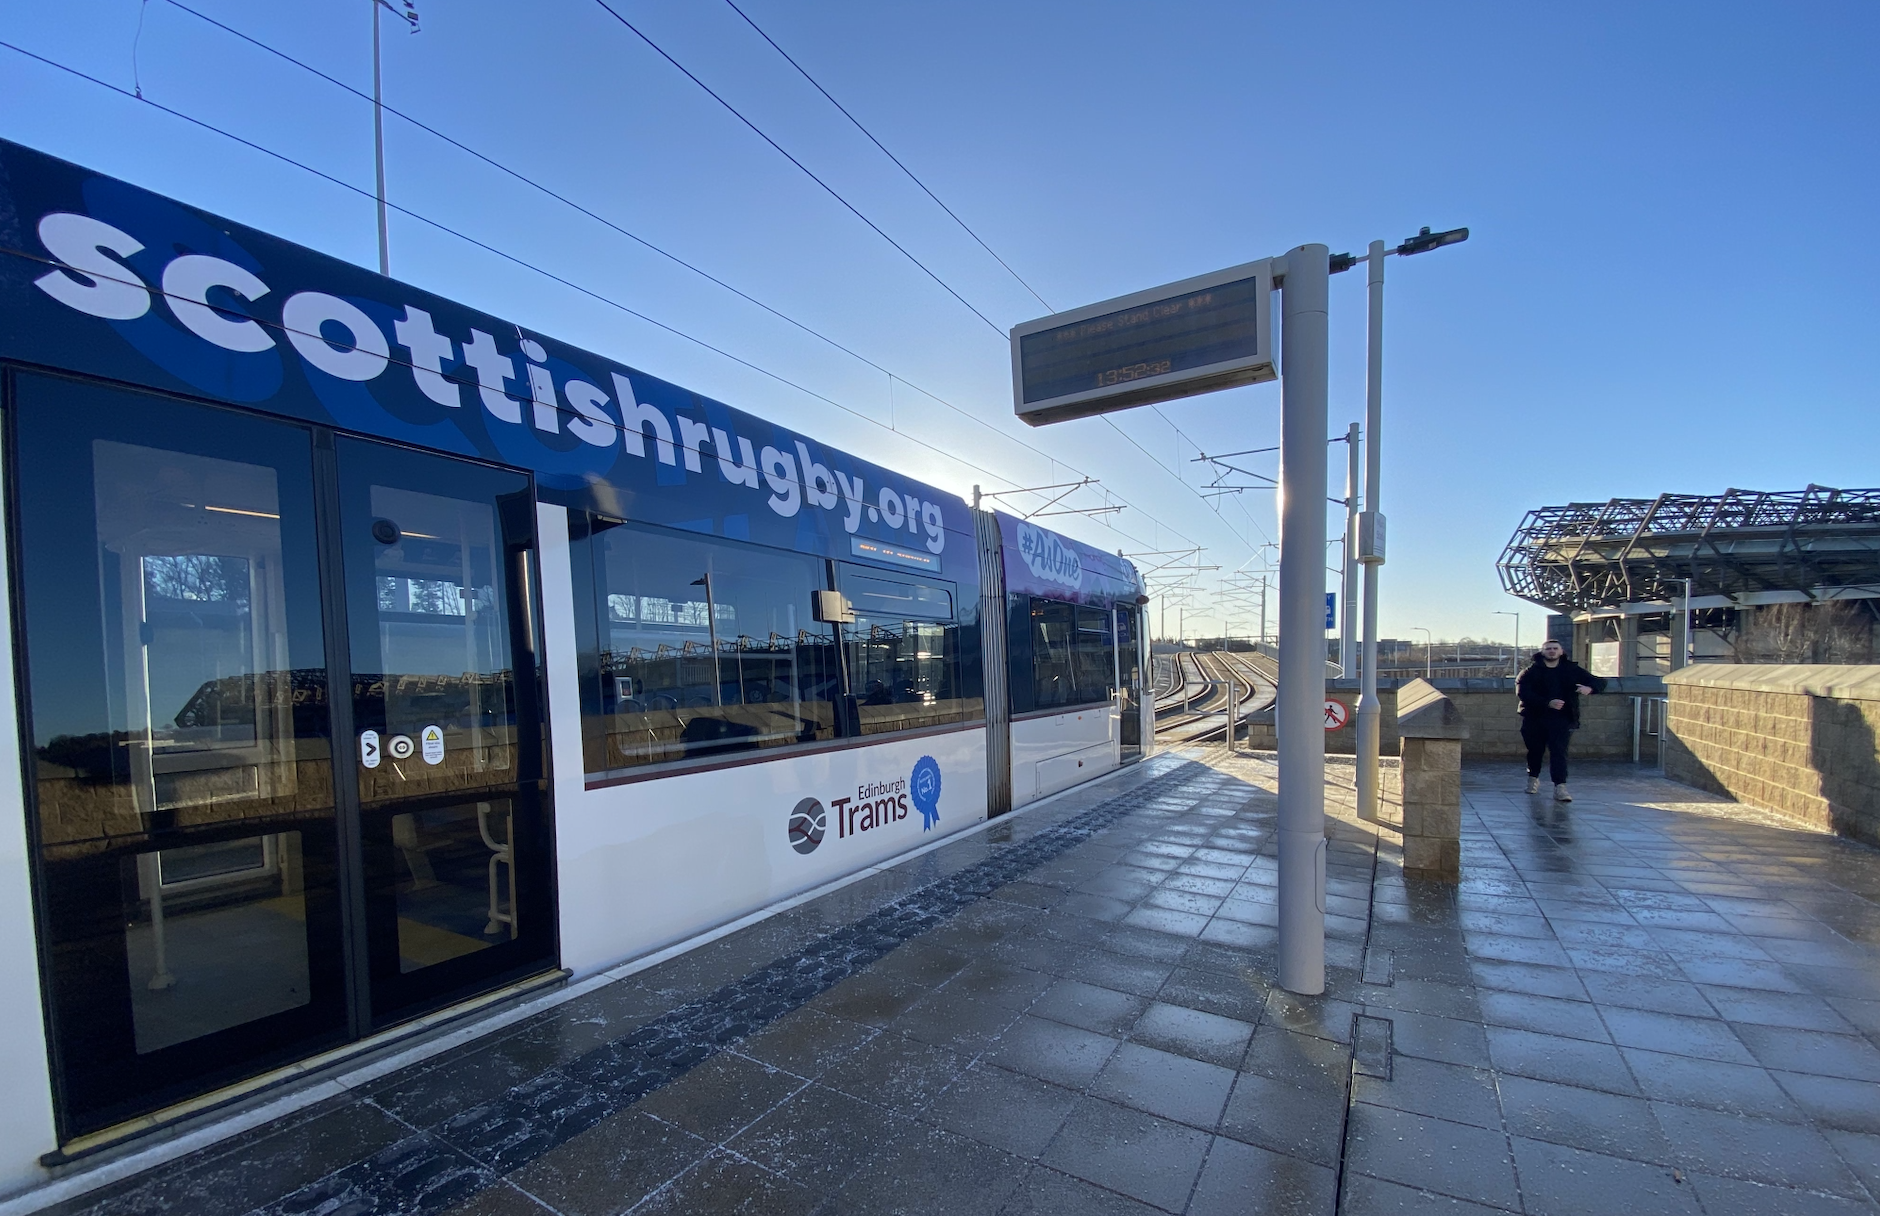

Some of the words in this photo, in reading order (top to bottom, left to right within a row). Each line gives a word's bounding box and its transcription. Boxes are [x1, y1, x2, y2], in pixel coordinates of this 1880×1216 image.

[1080, 321, 1113, 337] Please
[1118, 310, 1150, 327] Stand
[1153, 303, 1182, 319] Clear
[33, 212, 946, 555] scottishrugby.org
[1096, 360, 1171, 387] 13:52:32
[1021, 530, 1080, 581] #AsOne
[858, 776, 906, 801] Edinburgh
[831, 793, 908, 839] Trams
